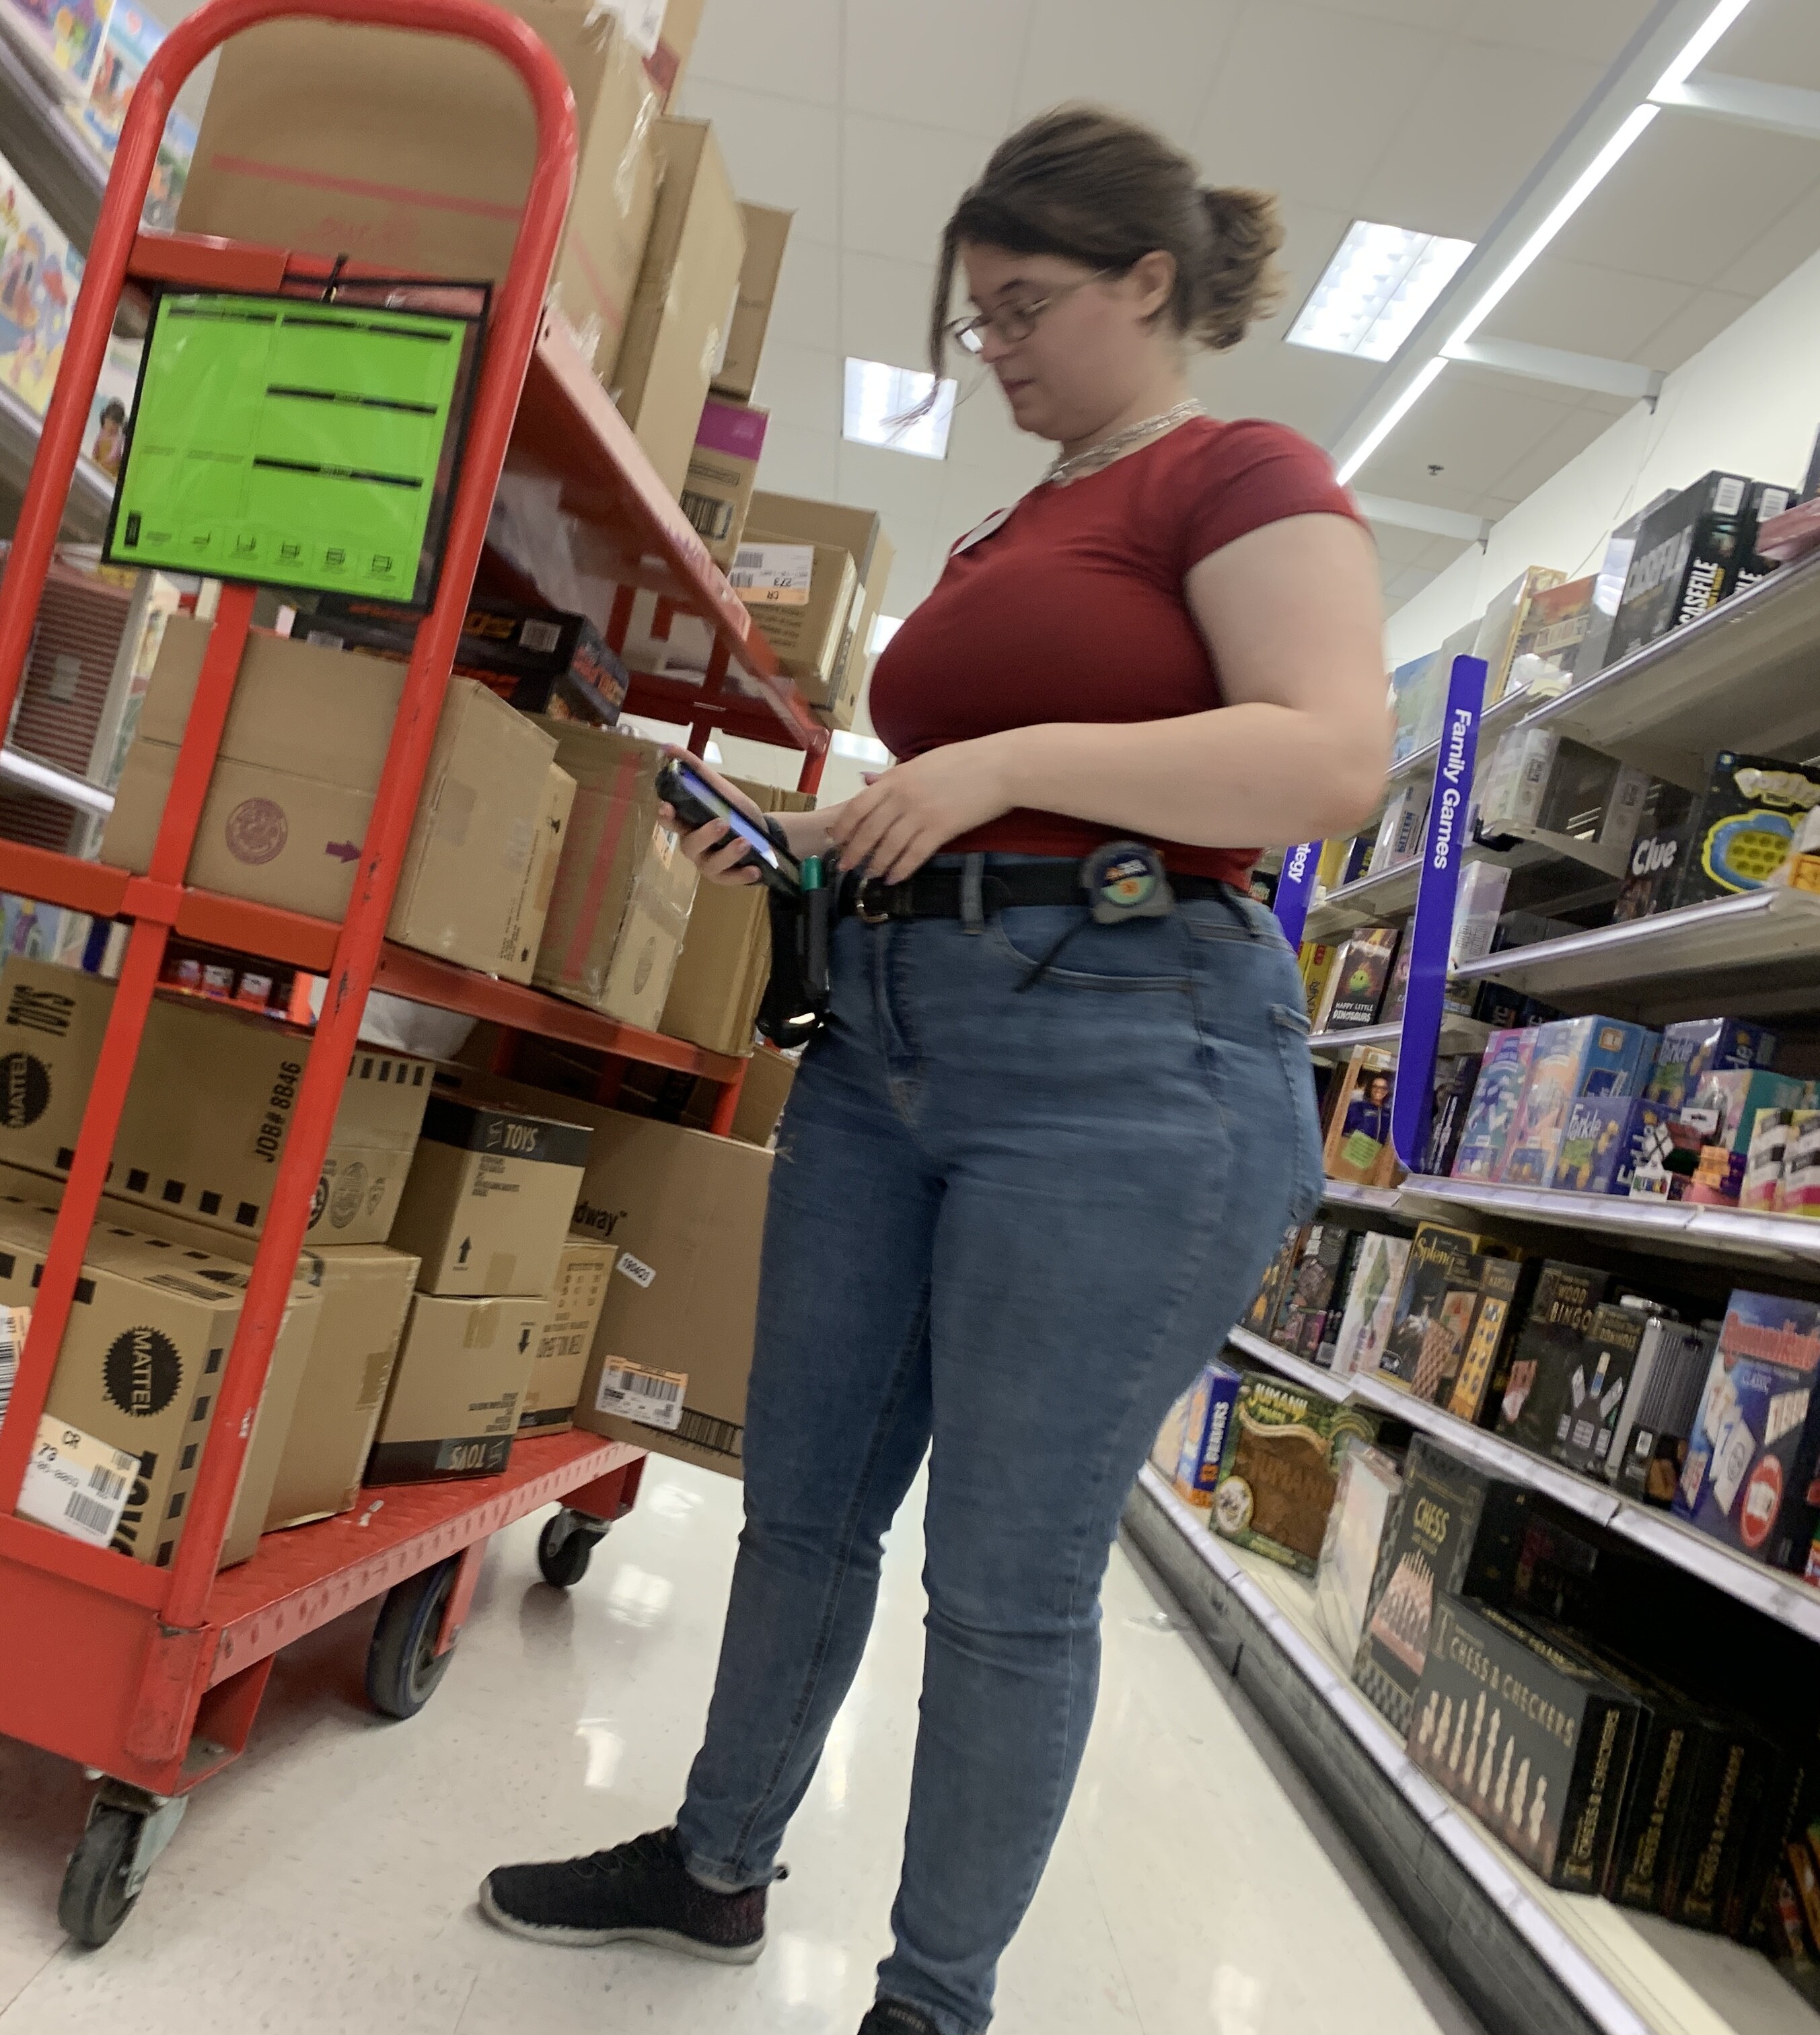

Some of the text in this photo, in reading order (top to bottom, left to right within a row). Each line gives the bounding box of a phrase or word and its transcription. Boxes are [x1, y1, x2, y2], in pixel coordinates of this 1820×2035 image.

[1434, 709, 1472, 870] Family Games
[1288, 843, 1312, 884] tegy
[1632, 836, 1678, 876] Clue
[5, 984, 76, 1037] TOYS
[1332, 1009, 1372, 1023] DINOSAURS
[1336, 1001, 1374, 1011] HAPPY LITTLE
[6, 1051, 30, 1129] MATTEL
[254, 1060, 302, 1164] JOB# 8B46
[1567, 1102, 1602, 1140] Farkle
[503, 1122, 539, 1153] TOYS
[1412, 1236, 1452, 1271] Splen
[1558, 1283, 1588, 1305] WOOD
[1549, 1301, 1593, 1332] BINGO
[131, 1329, 153, 1416] MATTEL
[448, 1443, 487, 1470] TOYS
[1413, 1496, 1451, 1544] CHESS
[1449, 1635, 1490, 1683] CHESS
[1501, 1672, 1575, 1749] CHECKERS
